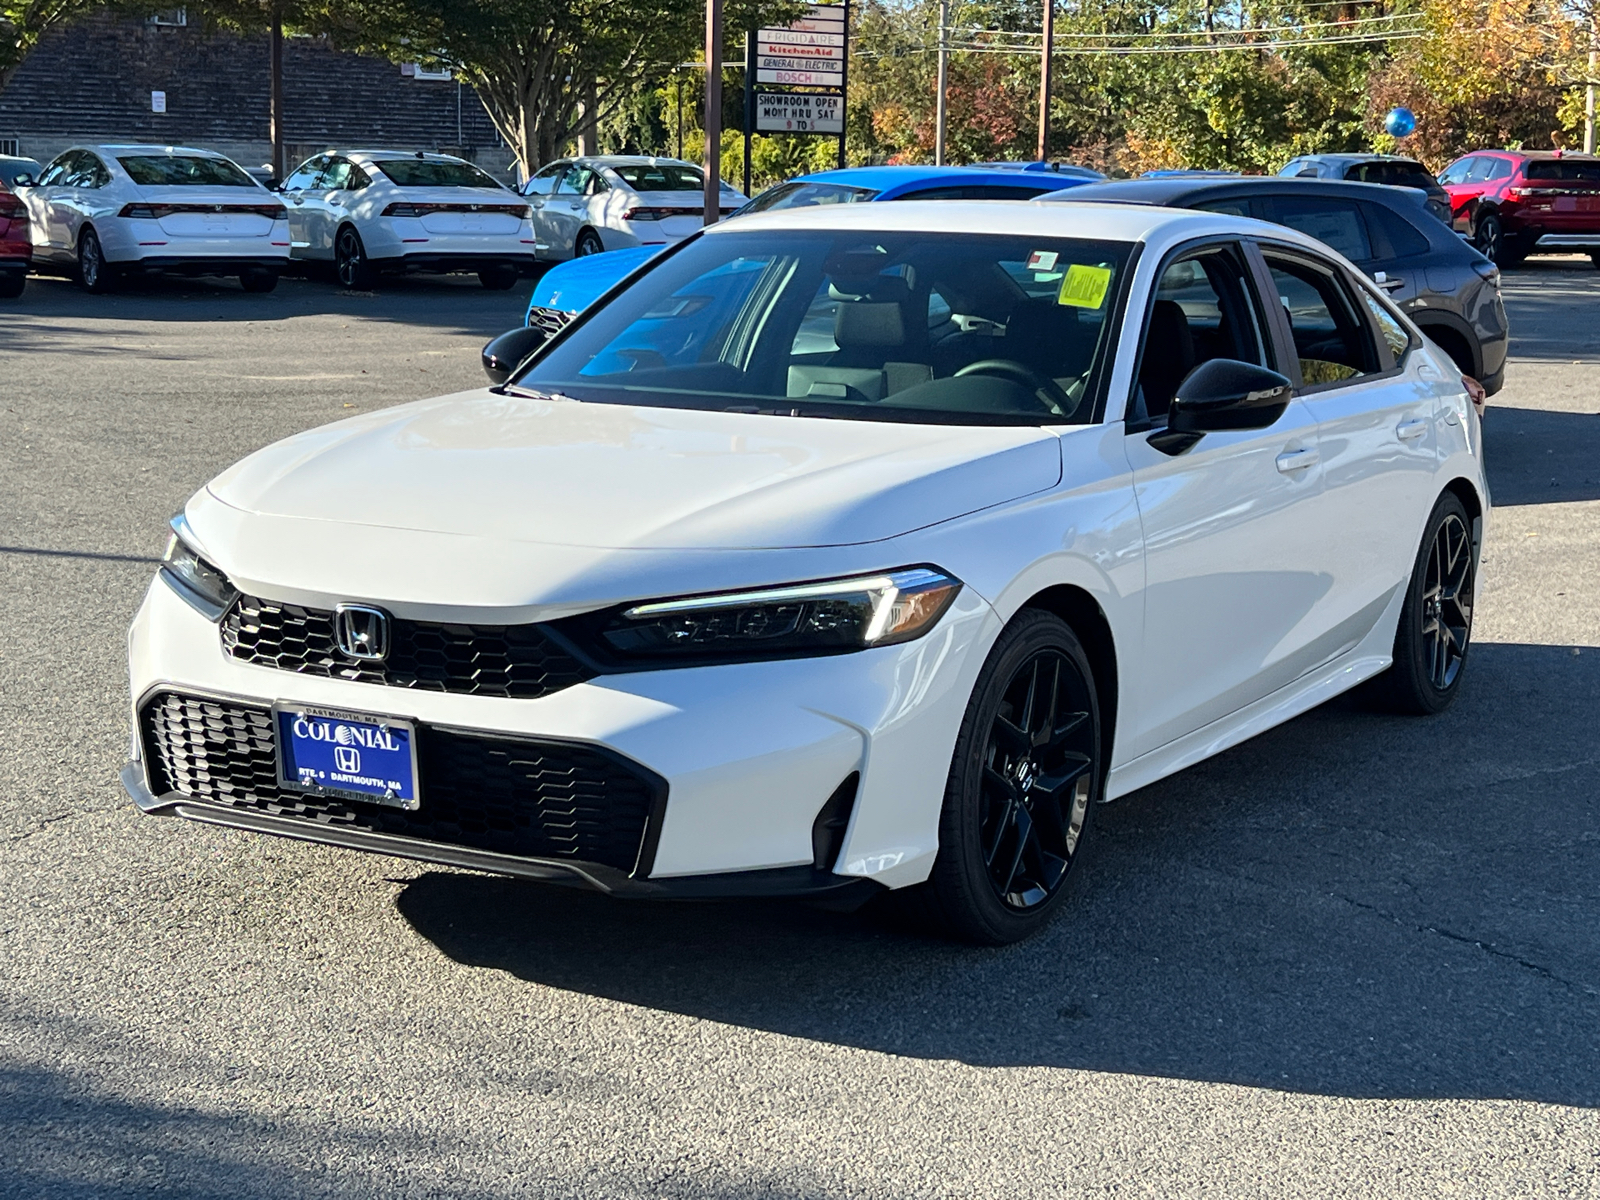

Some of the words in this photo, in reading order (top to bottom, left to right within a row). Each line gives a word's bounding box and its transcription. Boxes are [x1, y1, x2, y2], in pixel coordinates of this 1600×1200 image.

[767, 32, 835, 45] FRIGIDAIRE
[769, 45, 833, 56] KitchenAid
[763, 58, 795, 68] GENERAL
[804, 60, 838, 70] ELECTRIC
[776, 71, 812, 83] BOSCH
[759, 95, 810, 106] SHOWROOM
[815, 98, 838, 108] OPEN
[791, 108, 812, 118] HRU
[817, 109, 835, 119] SAT
[786, 120, 793, 130] 9
[796, 121, 808, 130] TO
[293, 719, 400, 751] COLONIAL
[299, 767, 318, 778] RTE.
[319, 770, 326, 779] 6
[330, 772, 387, 789] DARTMOUTH,
[388, 780, 403, 791] MA
